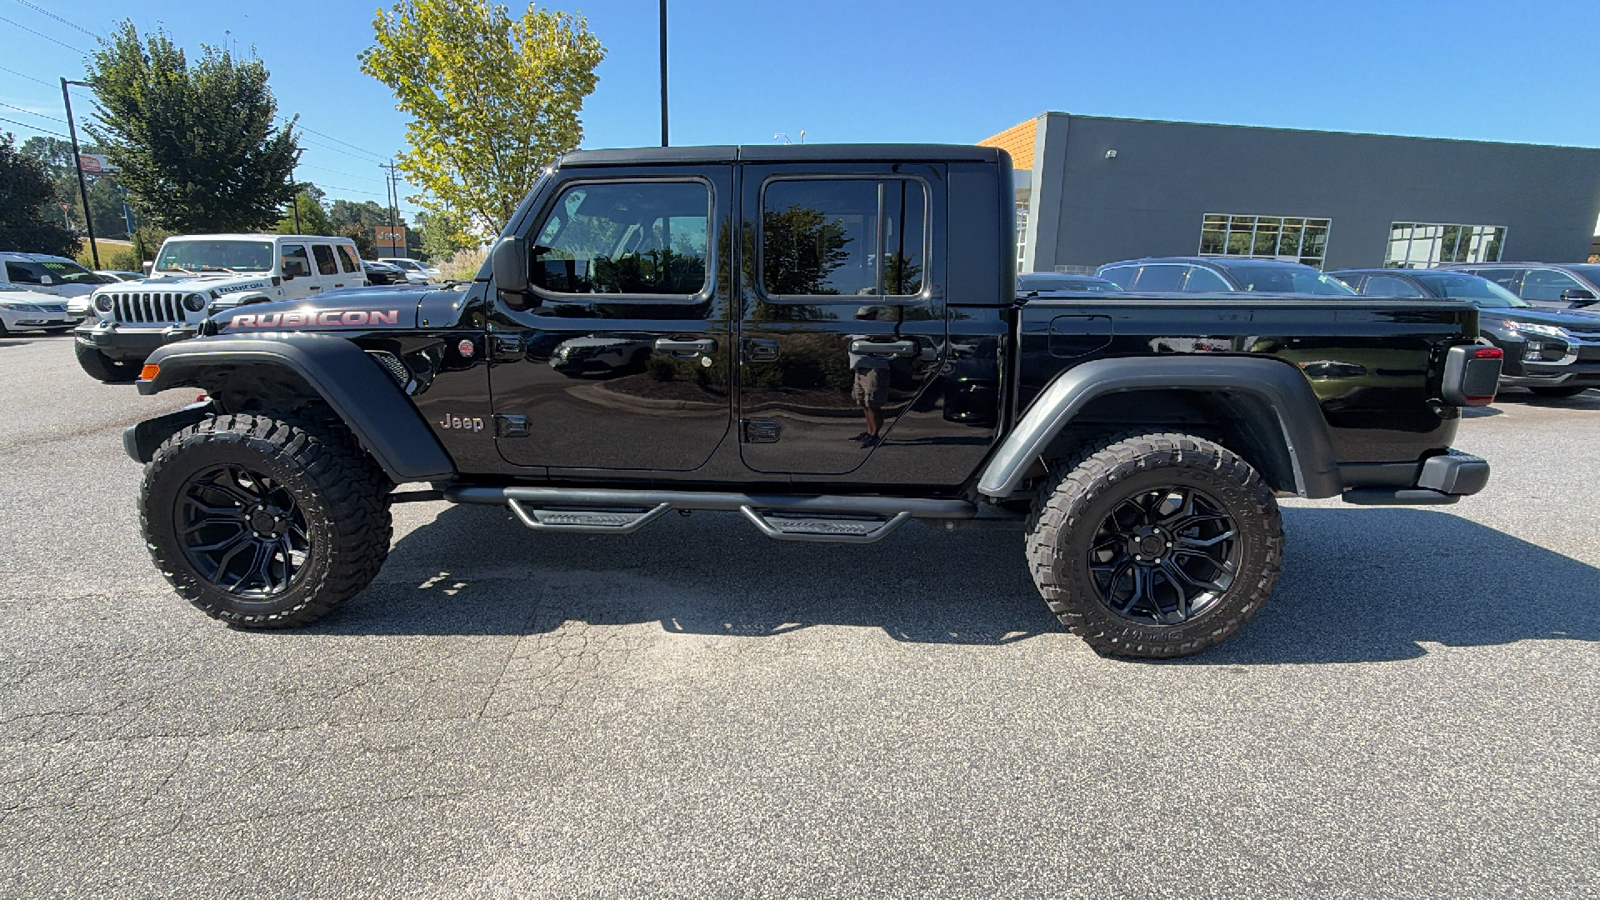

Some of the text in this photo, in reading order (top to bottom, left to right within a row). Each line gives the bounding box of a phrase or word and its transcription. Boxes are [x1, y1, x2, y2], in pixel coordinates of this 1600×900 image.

[219, 282, 264, 293] RUBICON
[229, 310, 399, 329] RUBICON
[440, 413, 485, 433] Jeep
